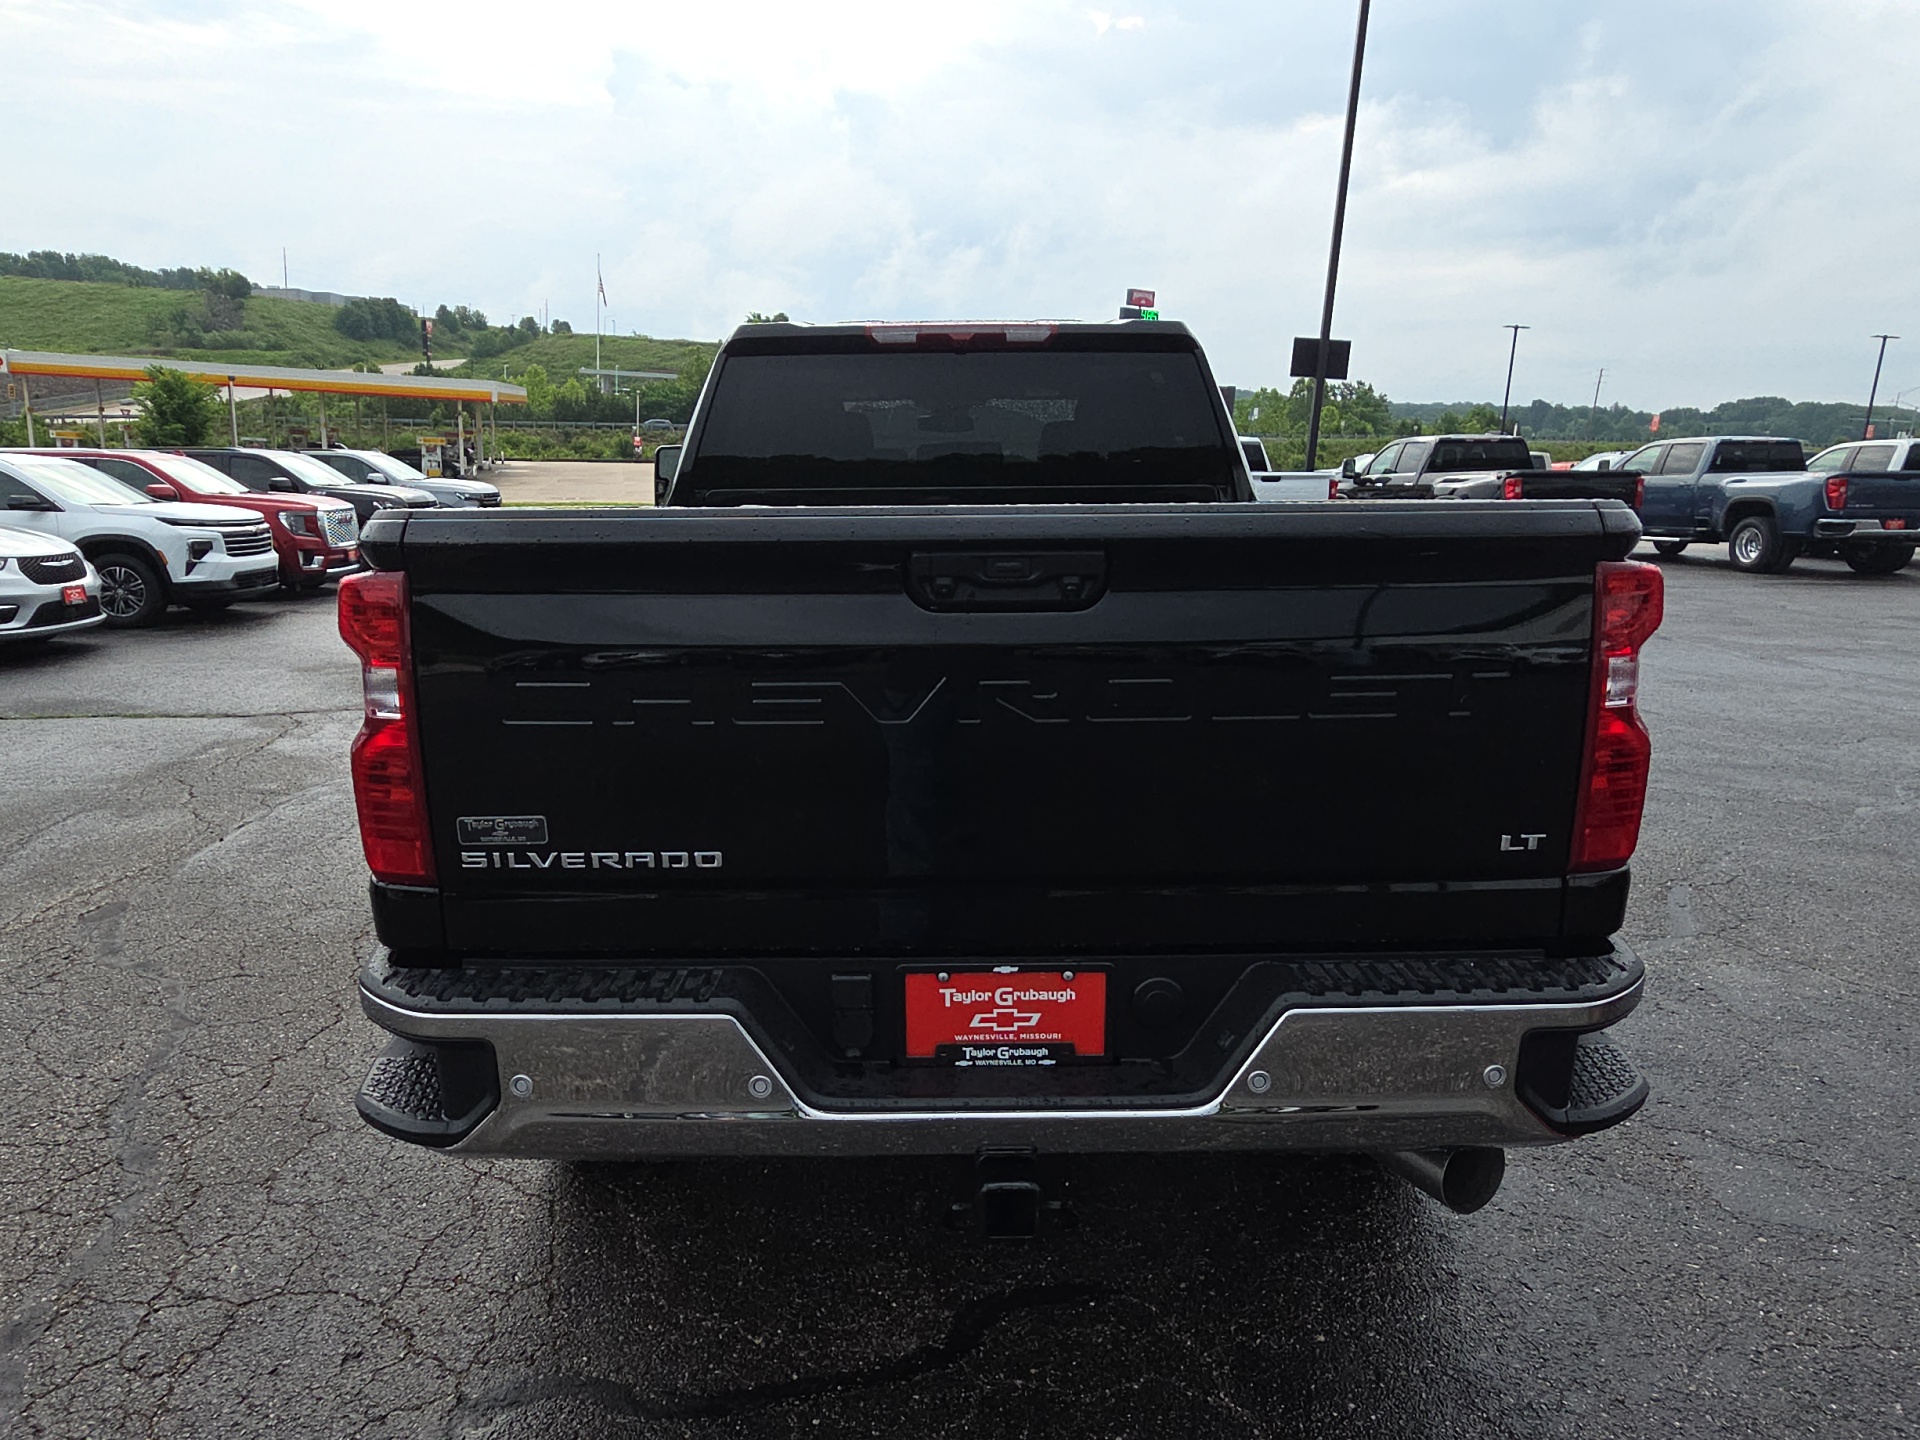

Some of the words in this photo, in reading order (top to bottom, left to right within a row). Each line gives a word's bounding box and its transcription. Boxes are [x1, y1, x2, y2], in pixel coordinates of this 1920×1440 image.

[1500, 833, 1547, 851] LT
[460, 851, 723, 869] SILVERADO
[939, 988, 992, 1007] Taylor
[994, 987, 1075, 1005] Grubaugh
[954, 1033, 1017, 1041] WAYNESVILLE,
[962, 1046, 995, 1059] Taylor
[997, 1046, 1048, 1058] Grubaugh
